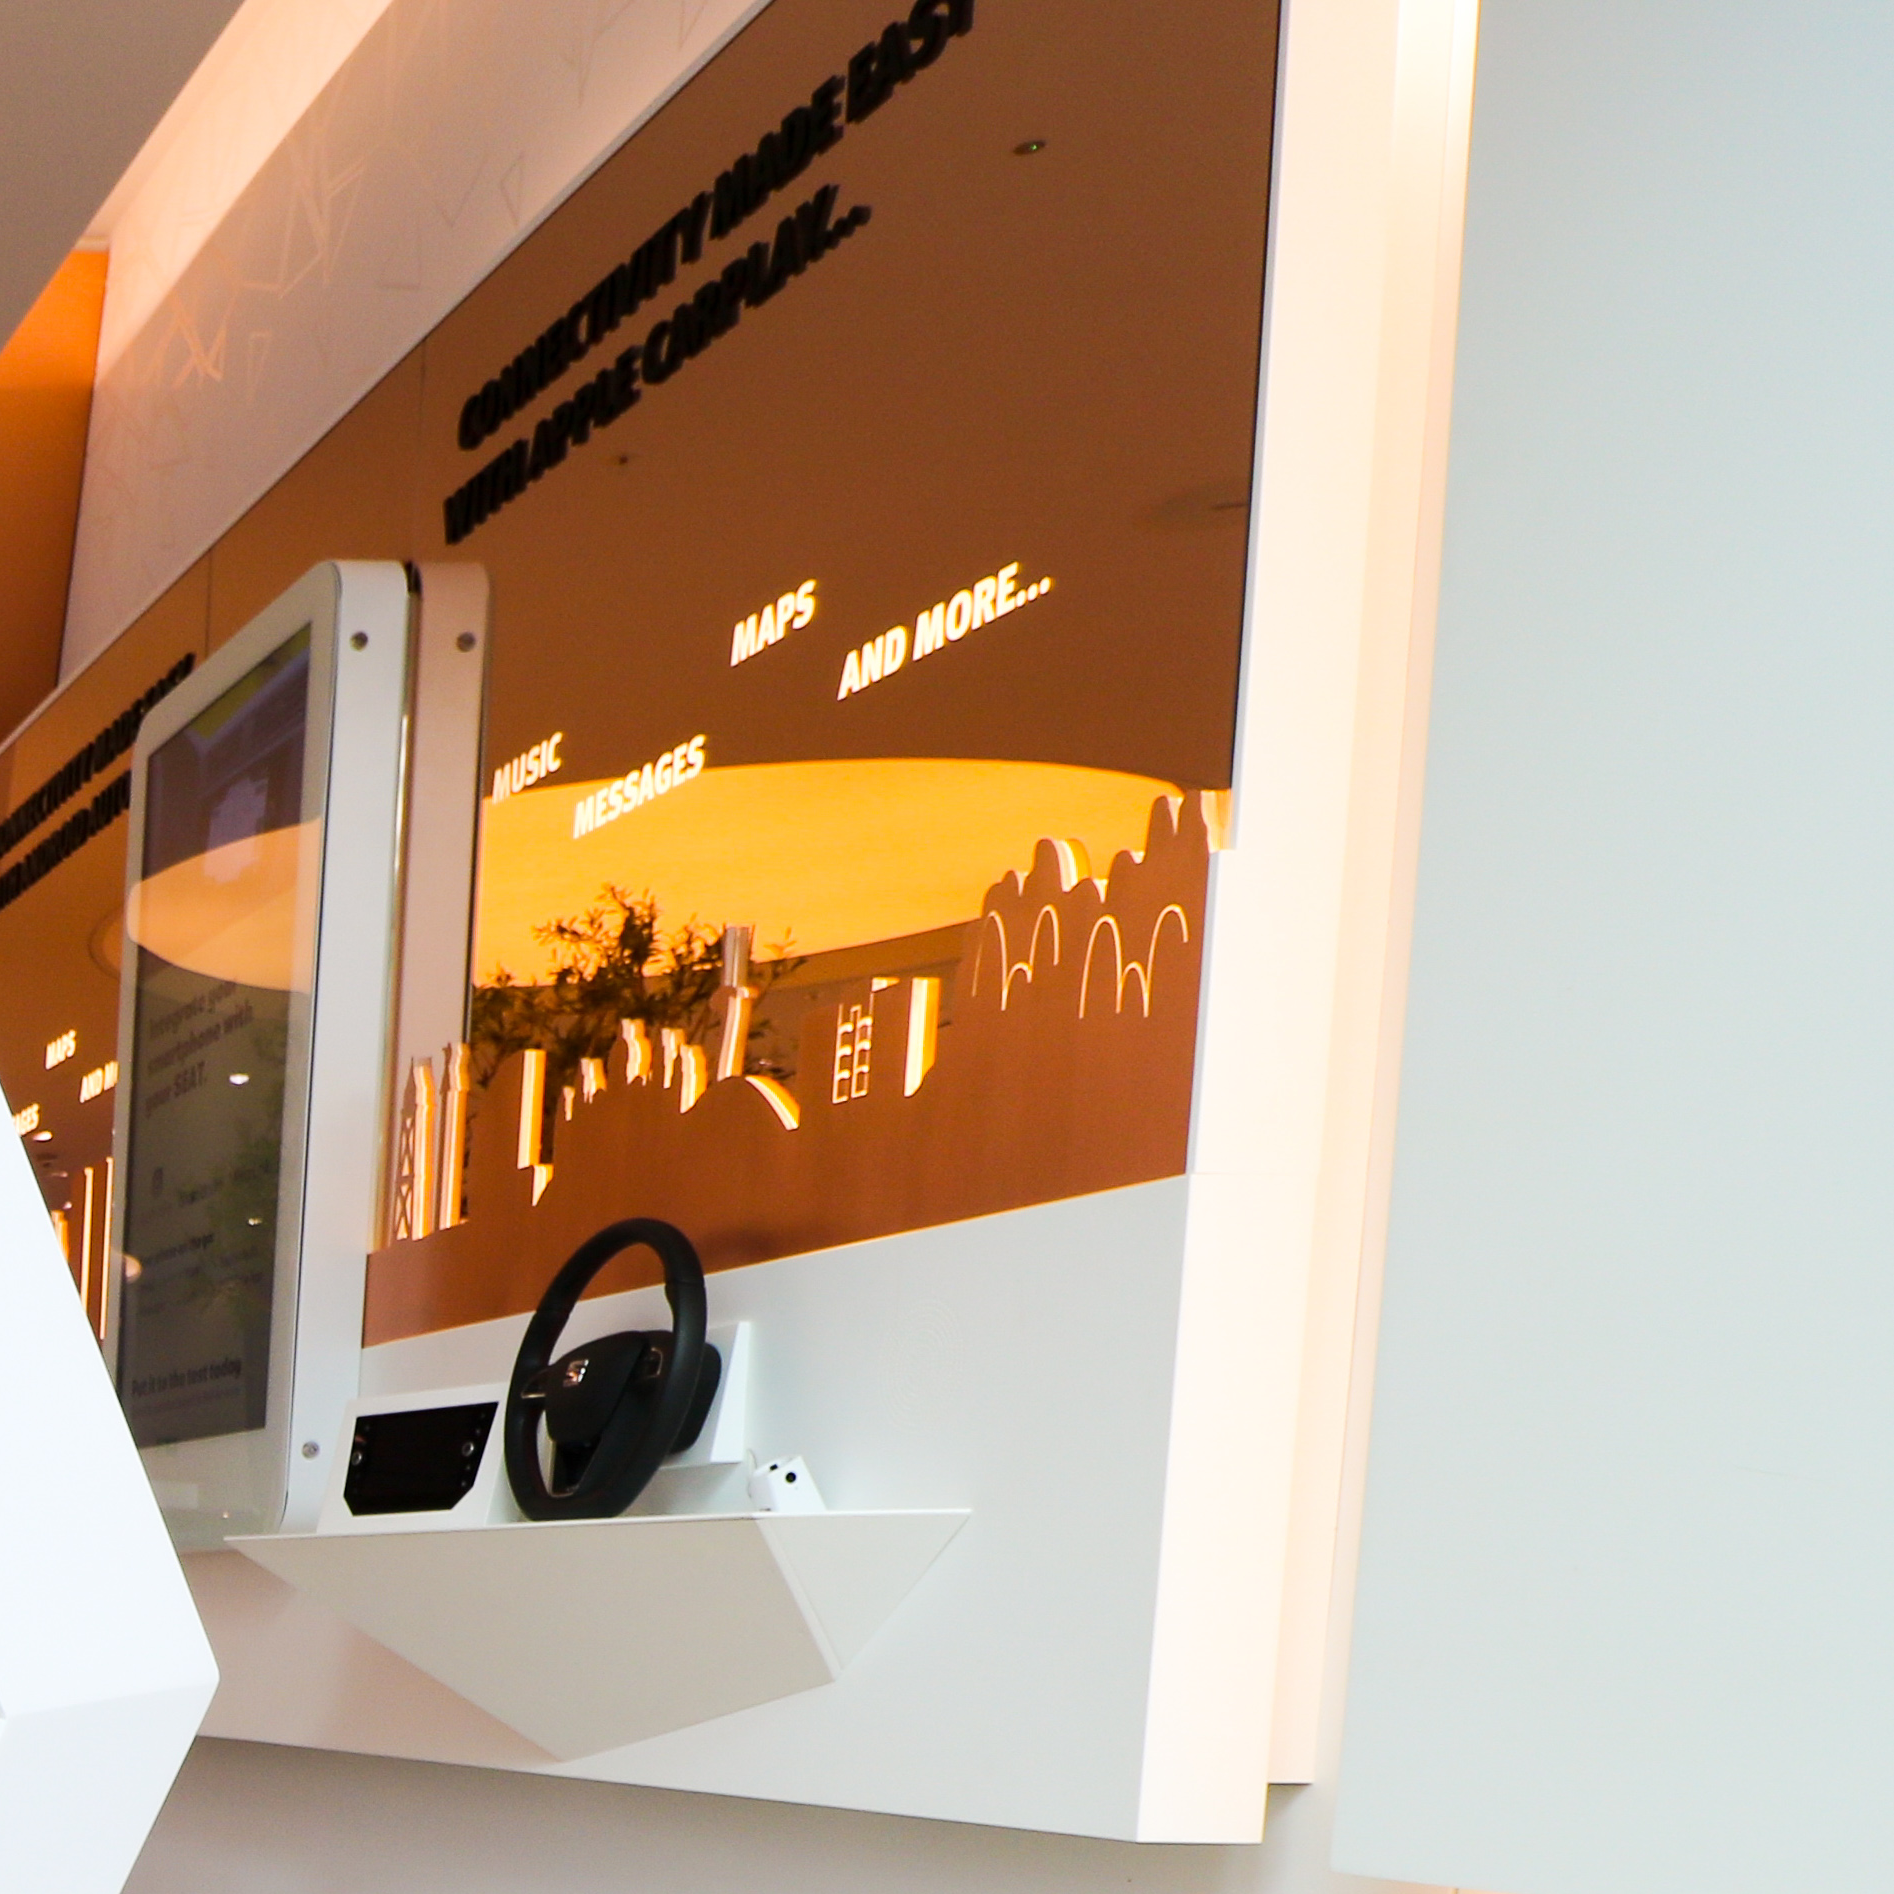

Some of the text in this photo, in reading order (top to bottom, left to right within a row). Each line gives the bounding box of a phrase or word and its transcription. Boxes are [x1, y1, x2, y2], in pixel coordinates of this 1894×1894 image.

[457, 190, 713, 451] CONNECTIVITY
[710, 74, 846, 241] MADE
[444, 439, 529, 546] WITH
[528, 345, 644, 484] APPLE
[730, 579, 817, 667] MAPS
[837, 561, 1054, 701] AND MORE...
[492, 731, 564, 805] MUSIC
[572, 733, 707, 839] MESSAGES
[45, 1029, 77, 1070] MAPS
